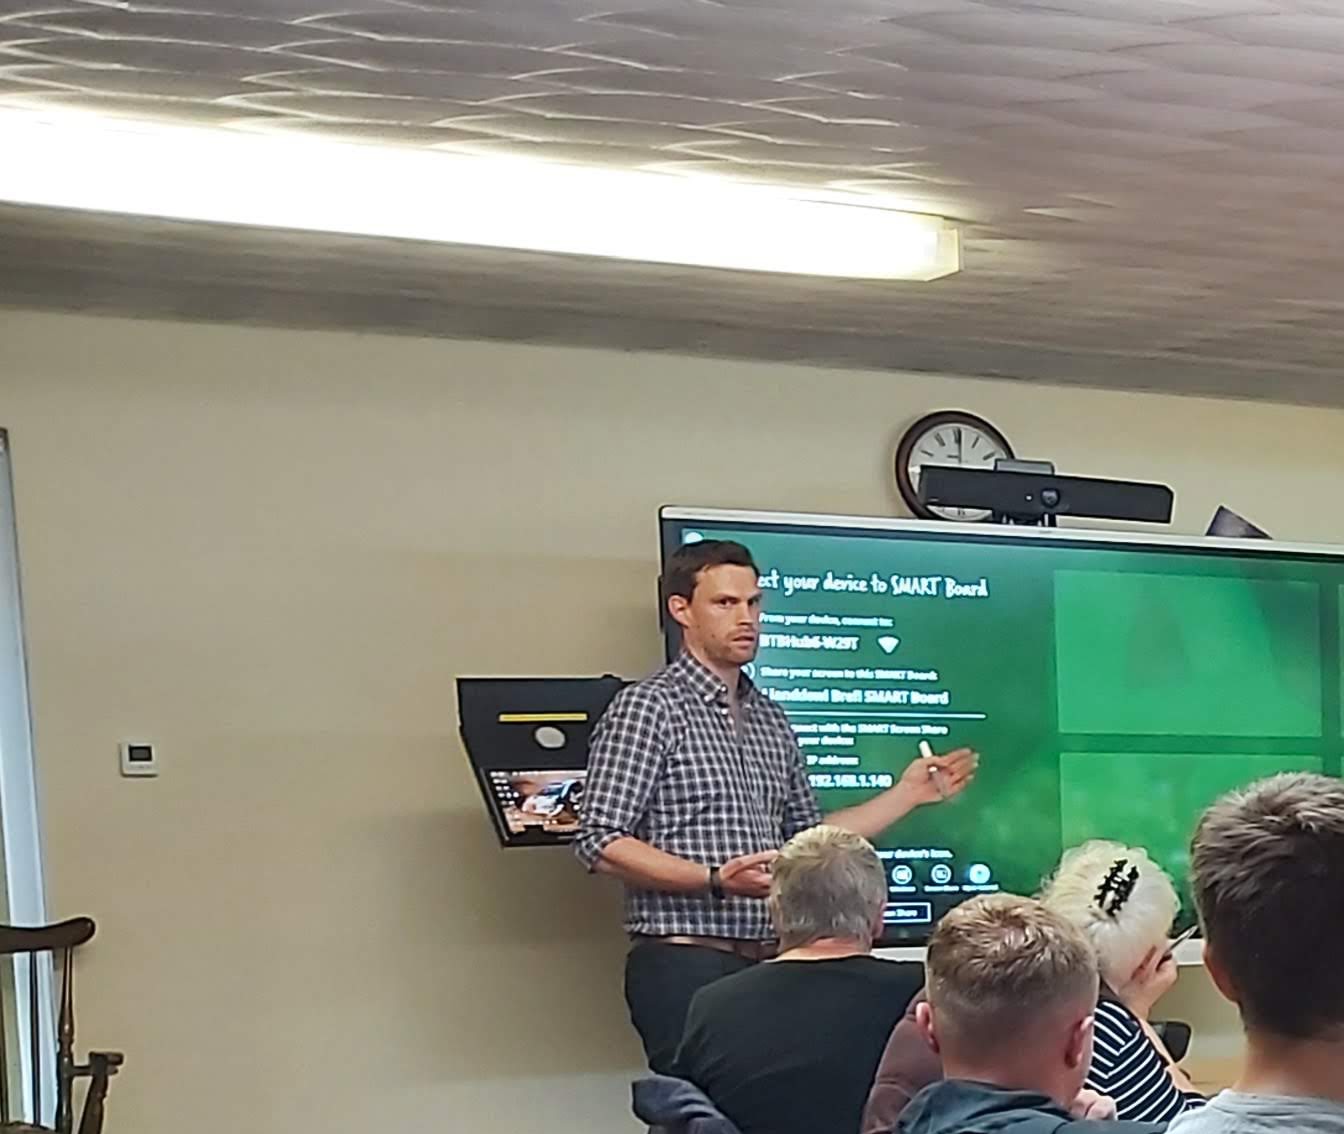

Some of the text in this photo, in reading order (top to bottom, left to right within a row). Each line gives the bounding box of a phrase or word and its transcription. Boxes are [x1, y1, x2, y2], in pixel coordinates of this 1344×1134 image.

[783, 575, 820, 597] your
[823, 571, 868, 594] device
[870, 573, 888, 594] to
[890, 575, 942, 597] SMART
[945, 577, 989, 598] Board
[864, 689, 910, 704] SMART
[911, 690, 949, 705] Board
